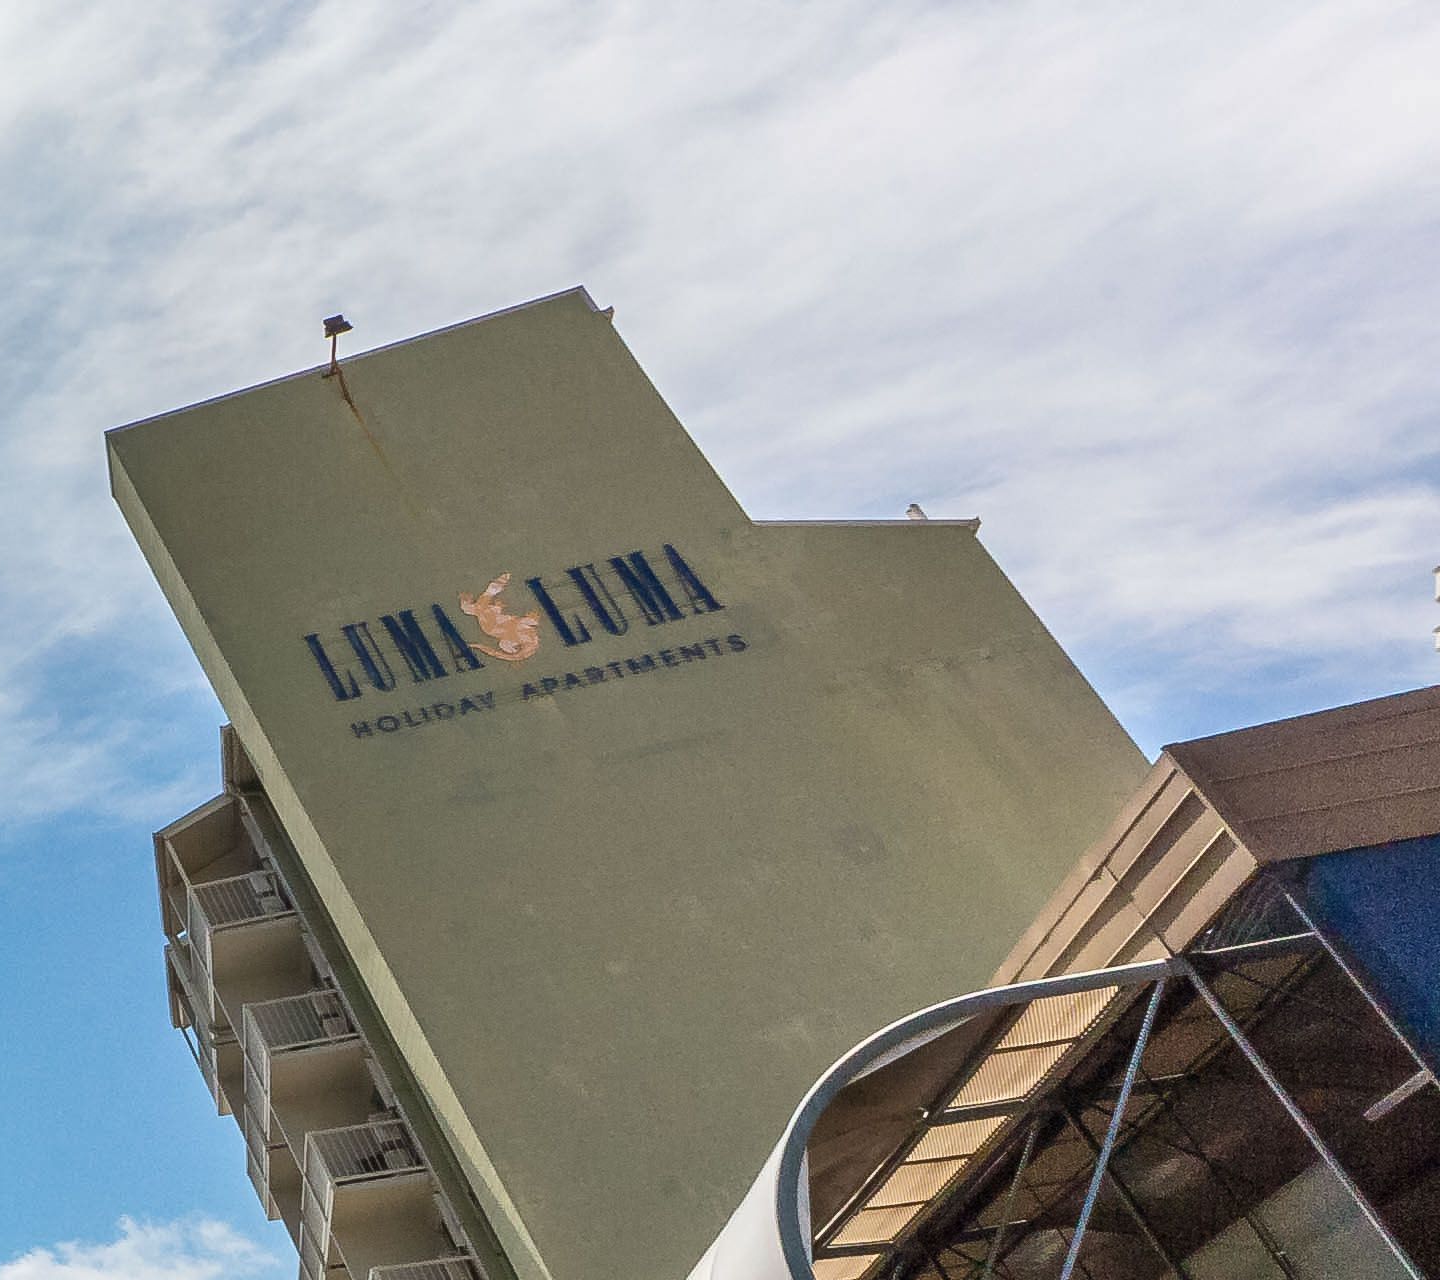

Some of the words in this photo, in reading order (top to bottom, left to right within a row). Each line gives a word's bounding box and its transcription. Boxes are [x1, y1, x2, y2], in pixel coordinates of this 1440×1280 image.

[304, 603, 485, 702] LUMA
[525, 543, 725, 647] LUMA
[350, 691, 496, 738] HOLIDAY
[520, 634, 751, 701] APARTMENTS
